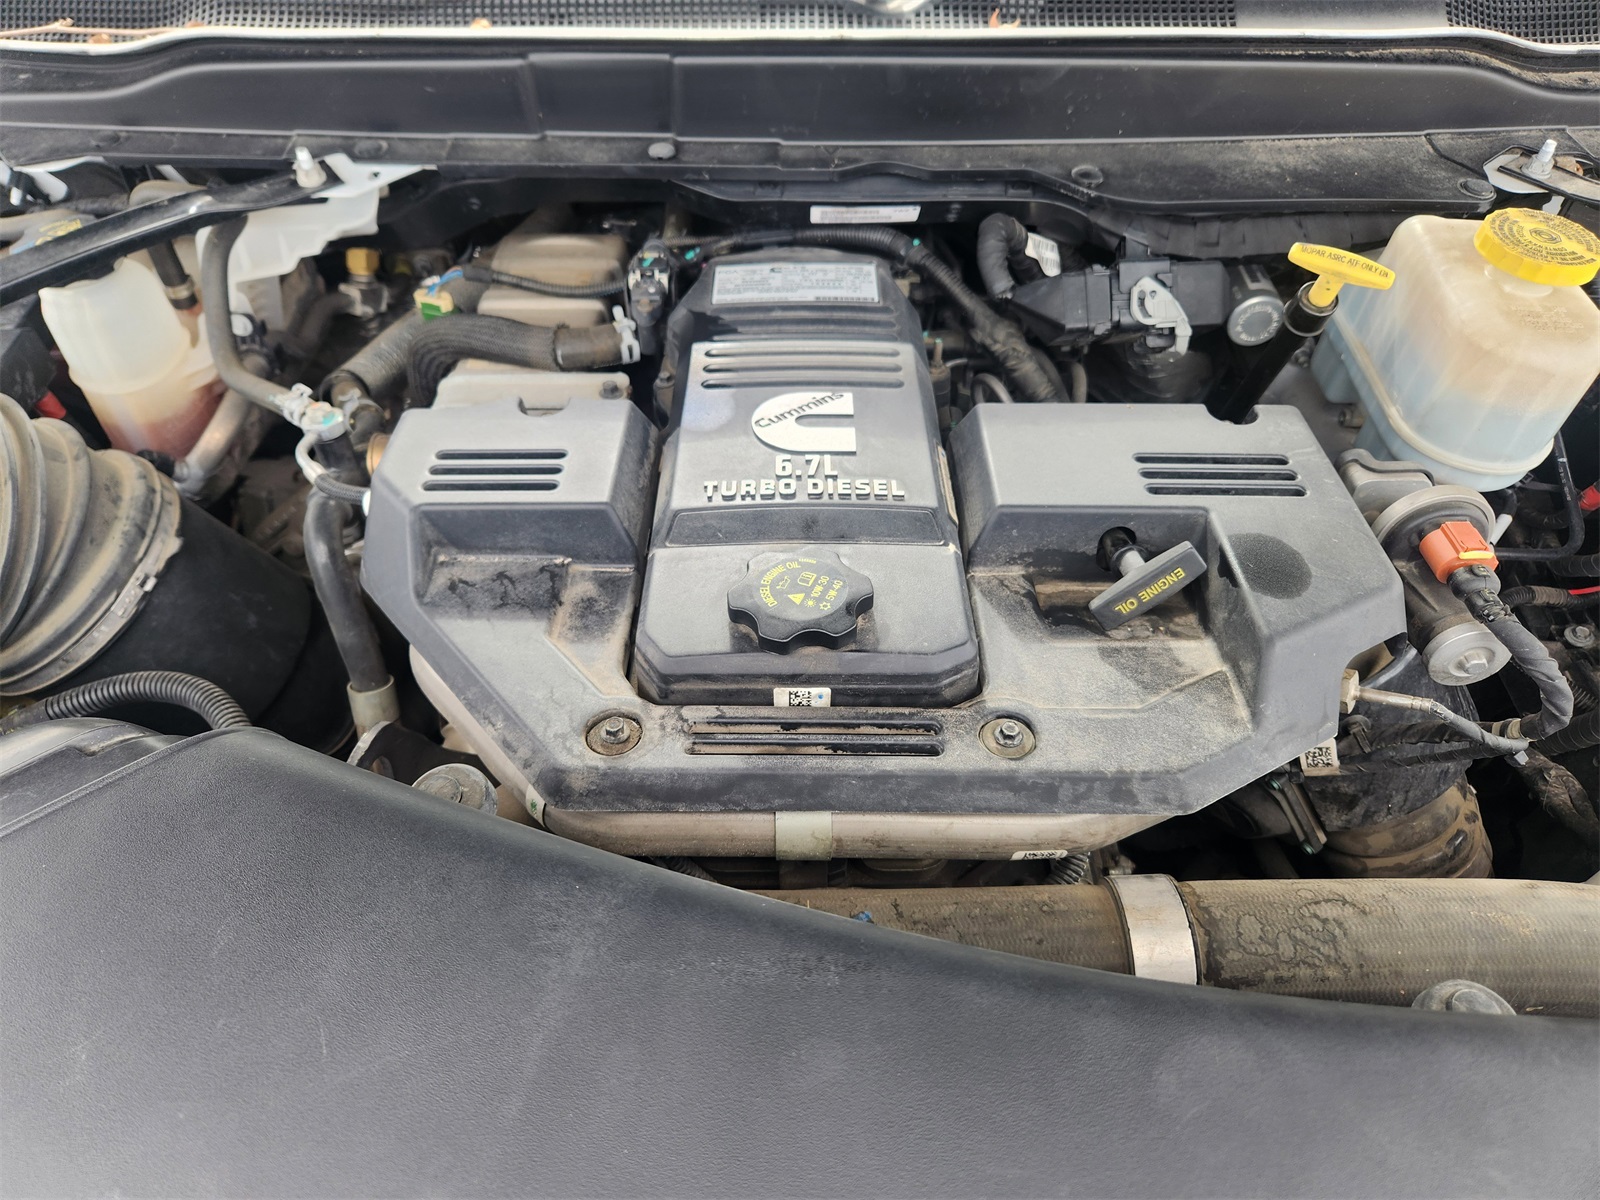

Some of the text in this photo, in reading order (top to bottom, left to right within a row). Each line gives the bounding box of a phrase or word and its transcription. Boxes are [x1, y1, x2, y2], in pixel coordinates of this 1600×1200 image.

[1301, 245, 1326, 257] MOPAR
[1361, 262, 1379, 273] ONLY
[754, 392, 844, 428] Cummins
[775, 454, 838, 479] 6.7L
[704, 478, 905, 499] TURBO DIESEL
[760, 561, 801, 607] DIESEL ENGINE OIL
[810, 575, 830, 597] 10W-30
[825, 579, 843, 601] 5W-40
[1114, 567, 1186, 614] ENGINE OIL
